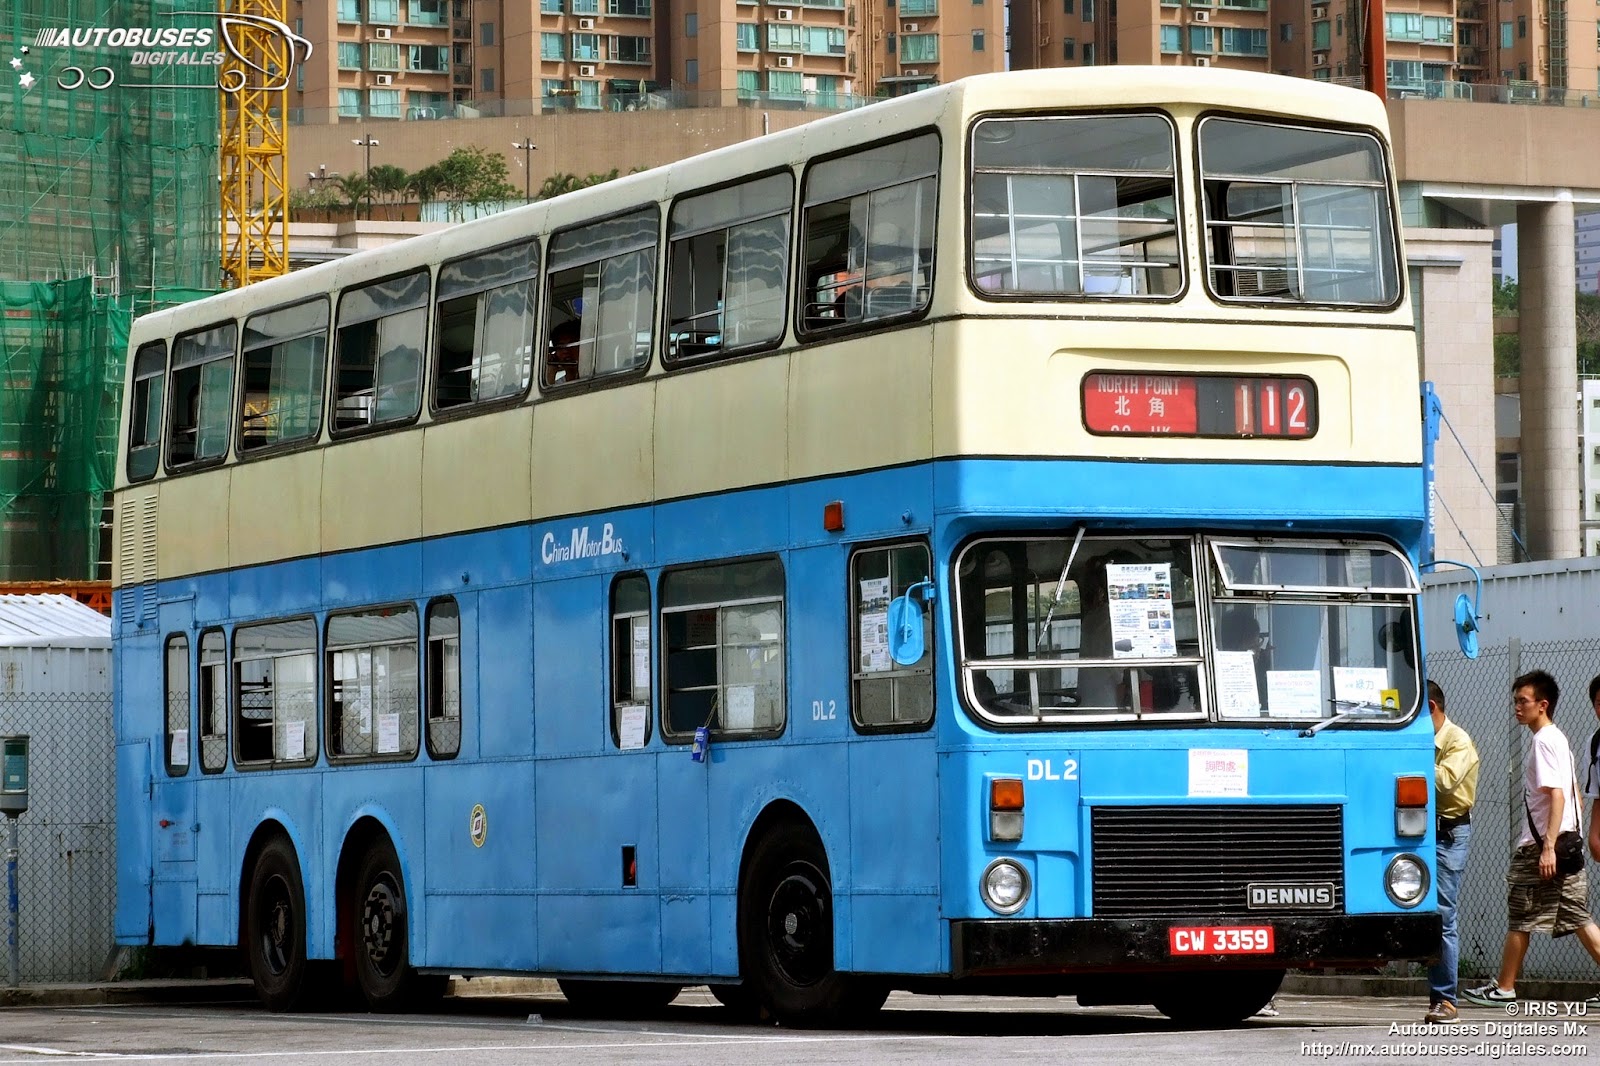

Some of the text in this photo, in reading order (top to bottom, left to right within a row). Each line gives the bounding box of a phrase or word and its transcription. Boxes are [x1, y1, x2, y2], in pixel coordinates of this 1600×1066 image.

[1098, 375, 1180, 395] NORTH POINT
[1252, 888, 1330, 904] DENNIS
[1175, 929, 1268, 951] CW 3359
